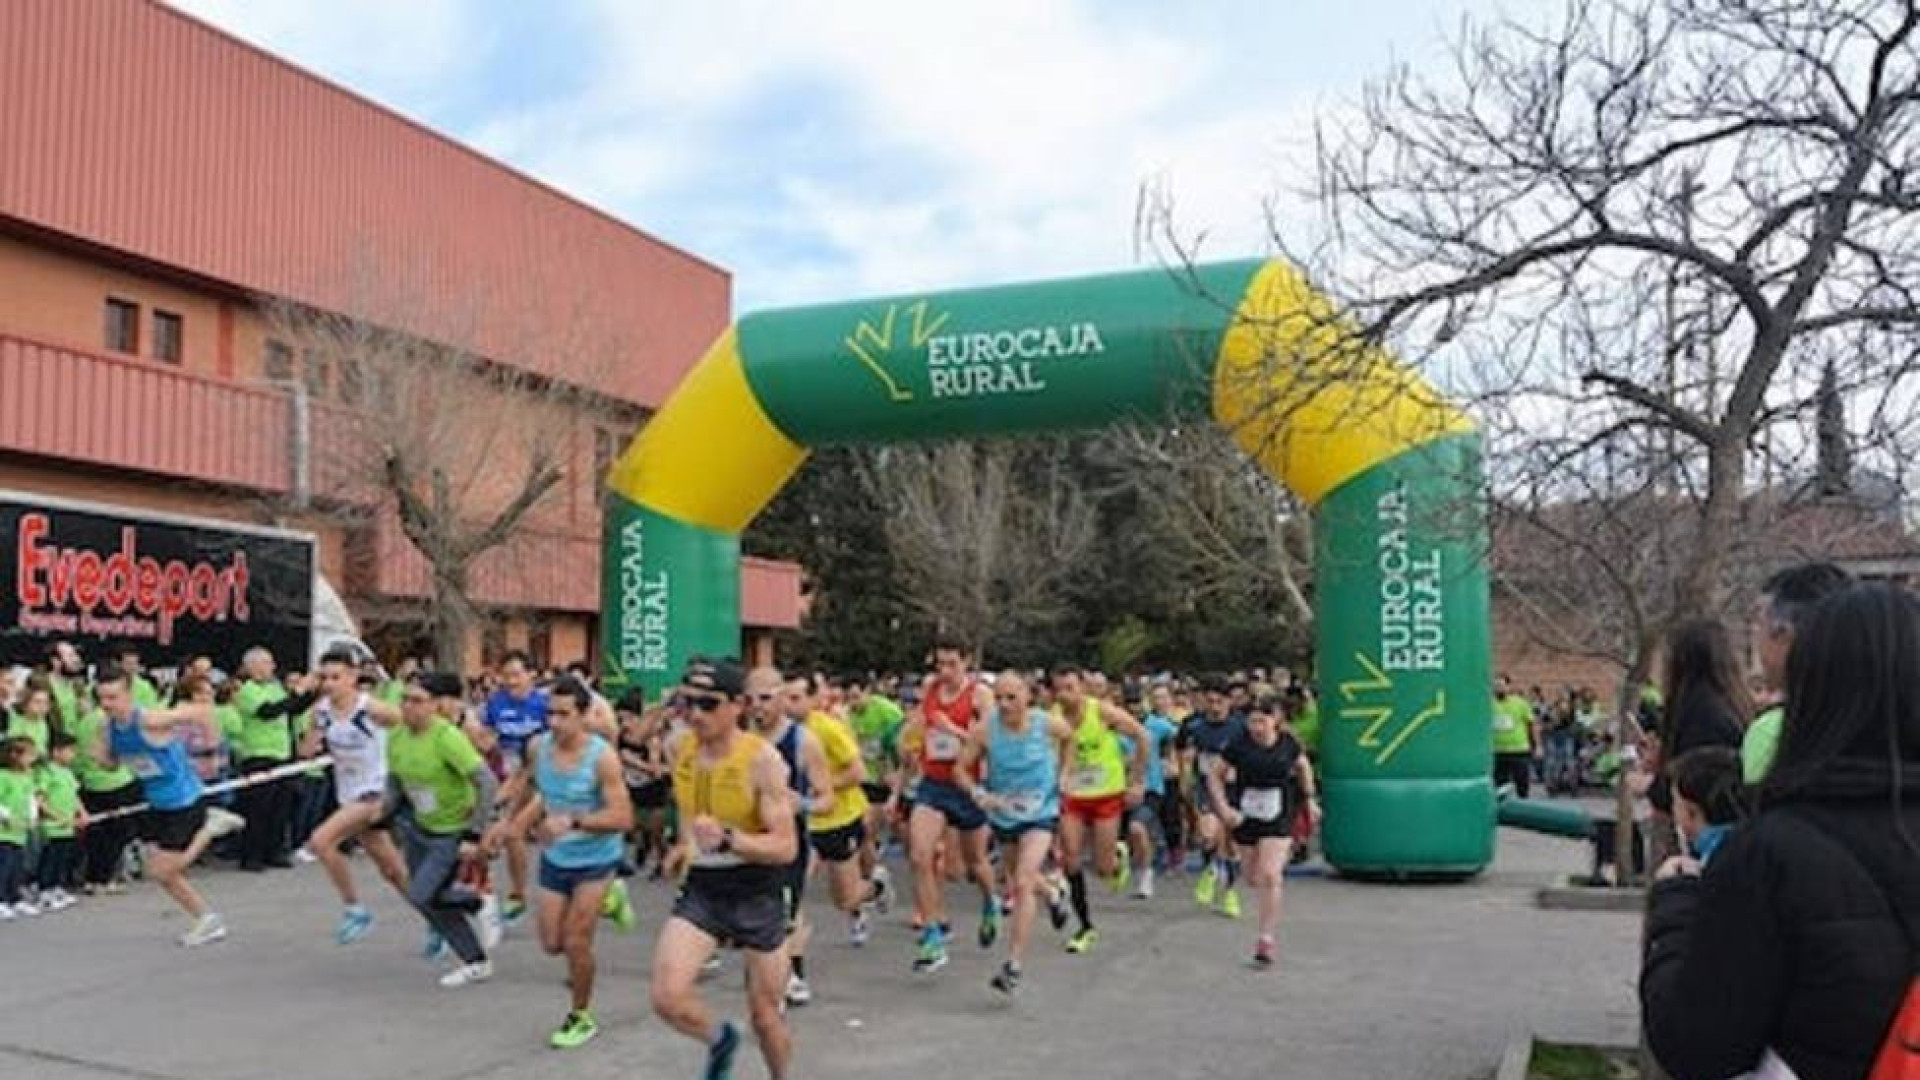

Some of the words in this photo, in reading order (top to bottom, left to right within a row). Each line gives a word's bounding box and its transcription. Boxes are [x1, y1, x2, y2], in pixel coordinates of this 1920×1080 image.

[927, 323, 1104, 366] EUROCAJA
[930, 362, 1046, 398] RURAL
[18, 513, 250, 646] Evedeport
[621, 519, 643, 670] EUROCAJA
[644, 571, 668, 670] RURAL
[1377, 481, 1411, 670] EUROCAJA
[1413, 549, 1444, 670] RURAL
